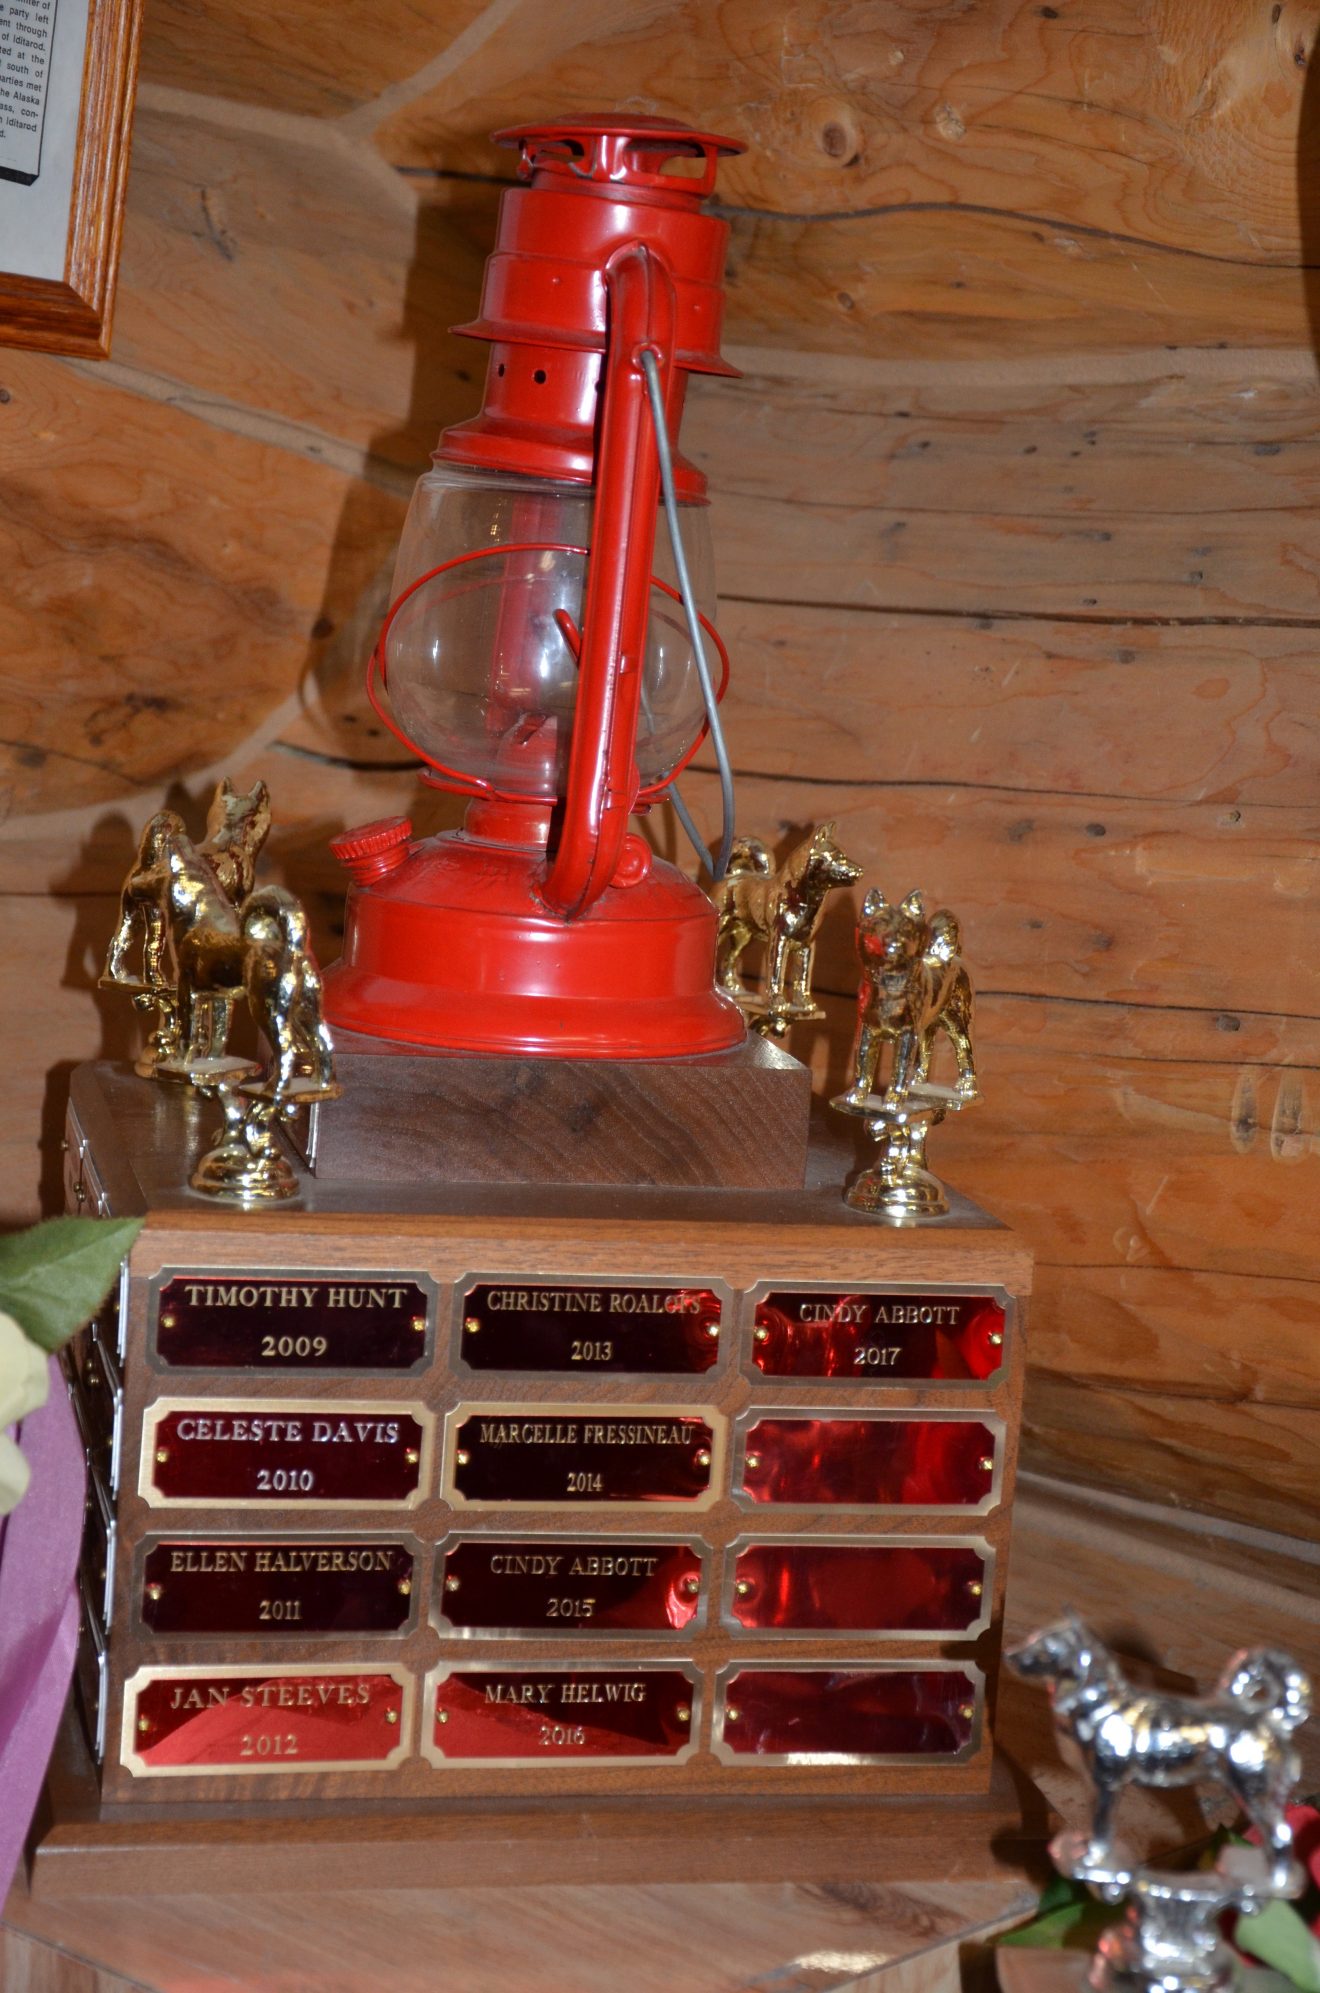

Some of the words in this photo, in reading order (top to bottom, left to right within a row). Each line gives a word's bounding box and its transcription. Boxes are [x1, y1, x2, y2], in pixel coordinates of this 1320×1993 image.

[9, 7, 30, 20] party
[35, 13, 49, 24] left
[42, 2, 51, 10] of
[2, 33, 10, 41] of
[16, 21, 48, 38] through
[17, 51, 25, 60] at
[31, 54, 45, 65] the
[6, 62, 29, 75] south
[34, 70, 43, 78] of
[0, 74, 23, 87] arties
[26, 82, 42, 93] met
[13, 91, 40, 106] Alaska
[20, 108, 39, 119] con-
[6, 116, 37, 132] Iditarod
[185, 1286, 319, 1308] TIMOTHY
[327, 1288, 408, 1309] HUNT
[487, 1290, 602, 1312] CHRISTINE
[799, 1304, 868, 1323] CINDY
[874, 1305, 960, 1325] ABBOTT
[261, 1336, 328, 1357] 2009
[571, 1341, 613, 1361] 2013
[853, 1347, 902, 1366] 2017
[176, 1419, 302, 1441] CELESTE
[311, 1422, 400, 1443] DAVIS
[480, 1423, 578, 1444] MARCELLE
[583, 1424, 696, 1445] FRESSINEAU
[256, 1469, 314, 1491] 2010
[566, 1472, 603, 1492] 2014
[170, 1551, 248, 1572] ELLEN
[254, 1550, 394, 1572] HALVERSON
[490, 1555, 565, 1575] CINDY
[568, 1557, 659, 1577] ABBOTT
[259, 1600, 303, 1620] 2011
[546, 1599, 596, 1618] 2015
[170, 1686, 230, 1709] JAN
[241, 1683, 371, 1707] STEEVES
[485, 1683, 555, 1703] MARY
[560, 1683, 647, 1703] HELWIG
[239, 1734, 299, 1755] 2012
[539, 1726, 586, 1745] 2016
